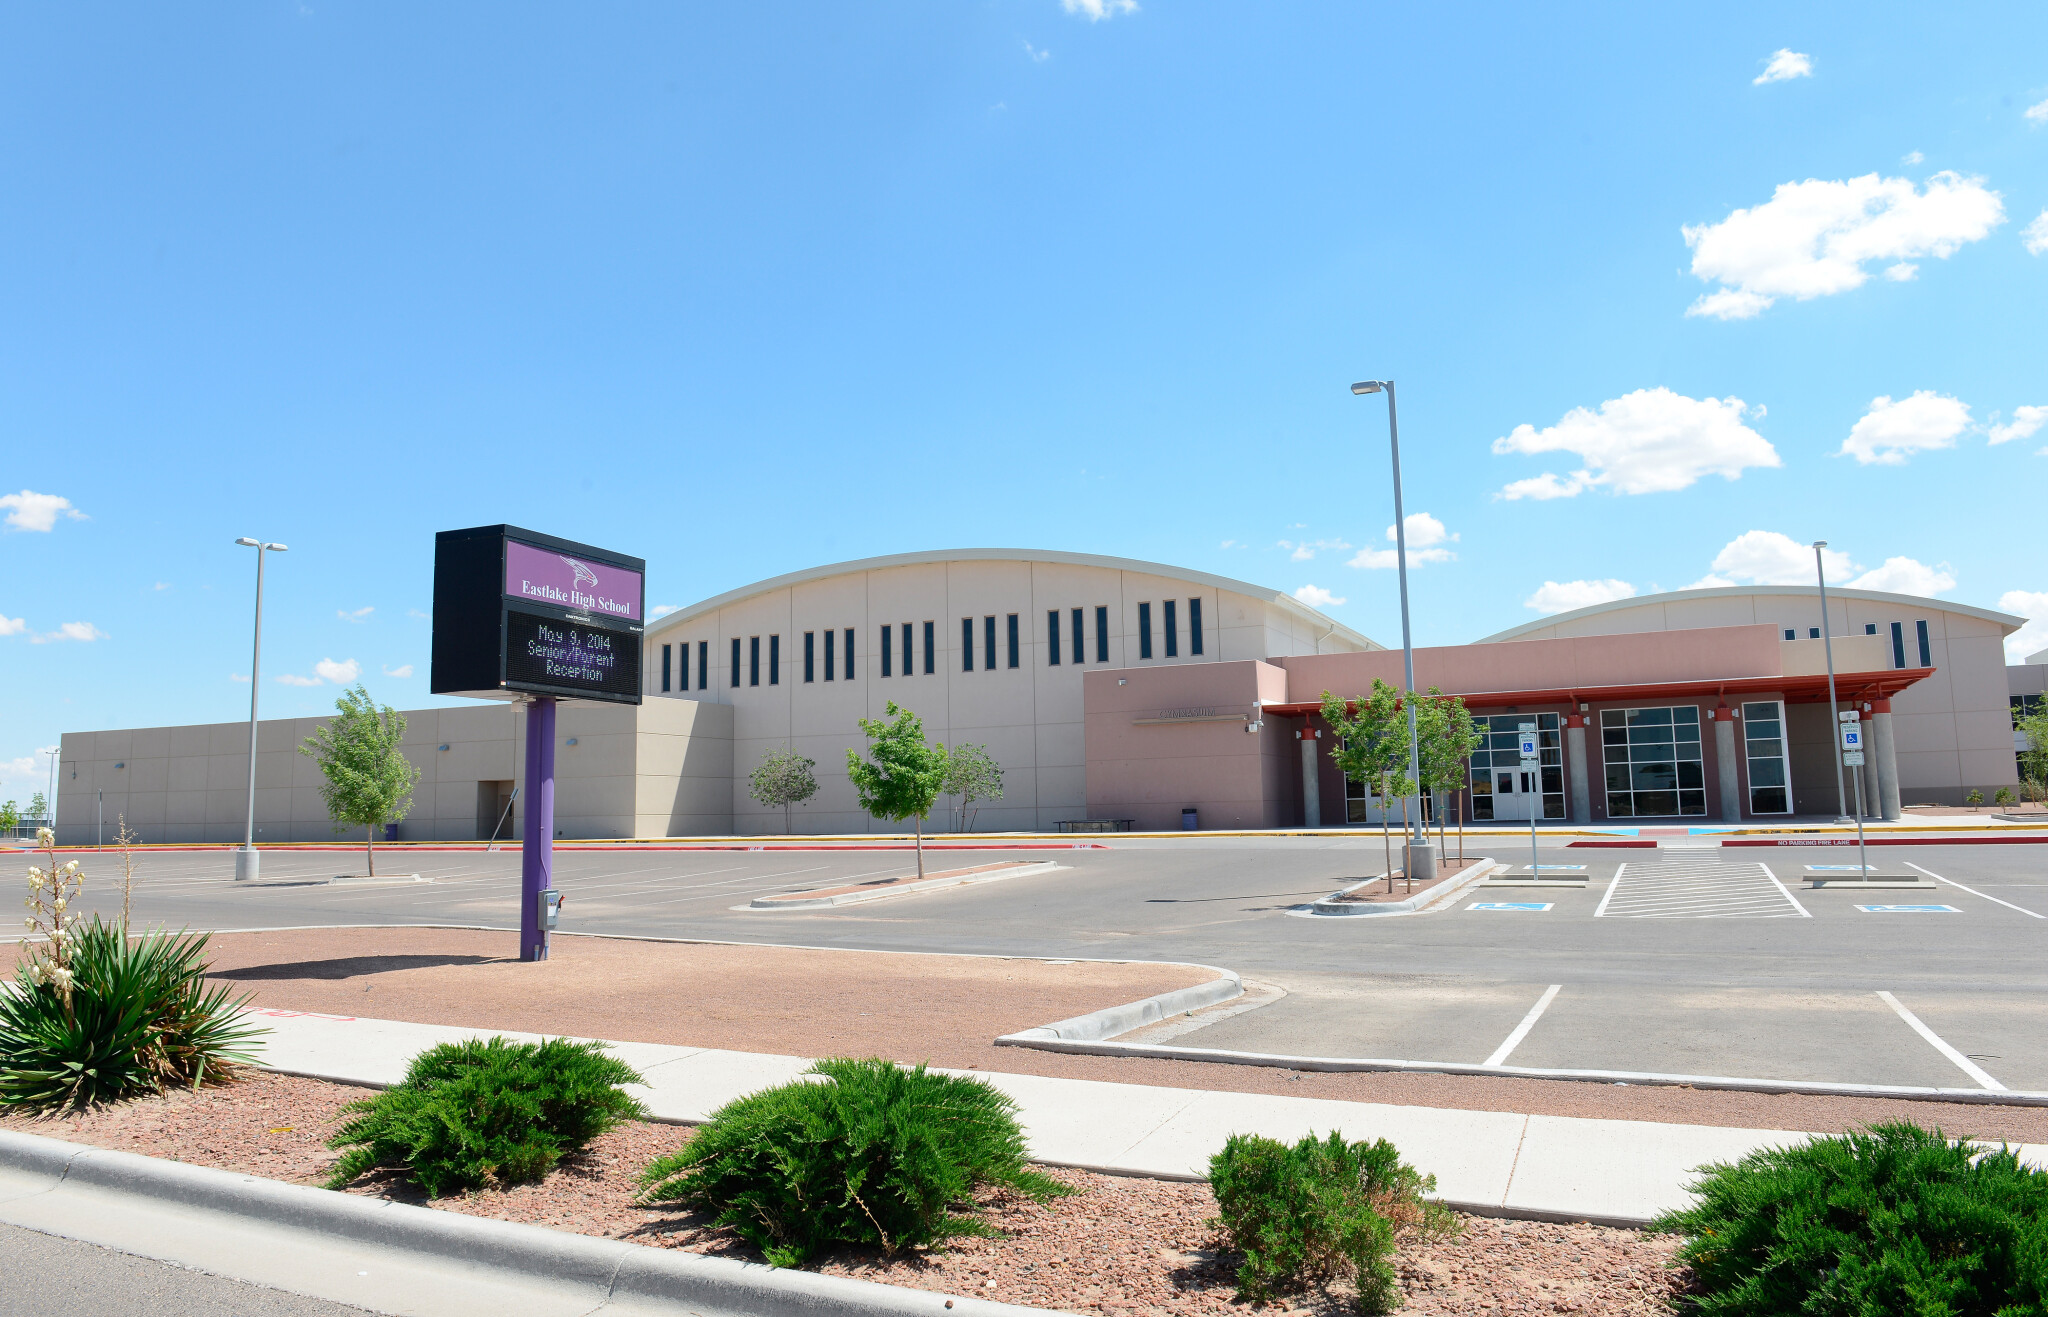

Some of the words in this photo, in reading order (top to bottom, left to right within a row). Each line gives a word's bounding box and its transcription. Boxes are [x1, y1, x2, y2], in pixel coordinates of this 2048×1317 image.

[522, 580, 568, 602] Eastlake
[571, 590, 595, 610] High
[598, 597, 630, 615] School
[538, 624, 563, 643] May
[570, 630, 581, 646] 9,
[587, 633, 611, 651] 2014
[528, 639, 615, 667] Senior/Parent
[546, 659, 603, 682] Reception
